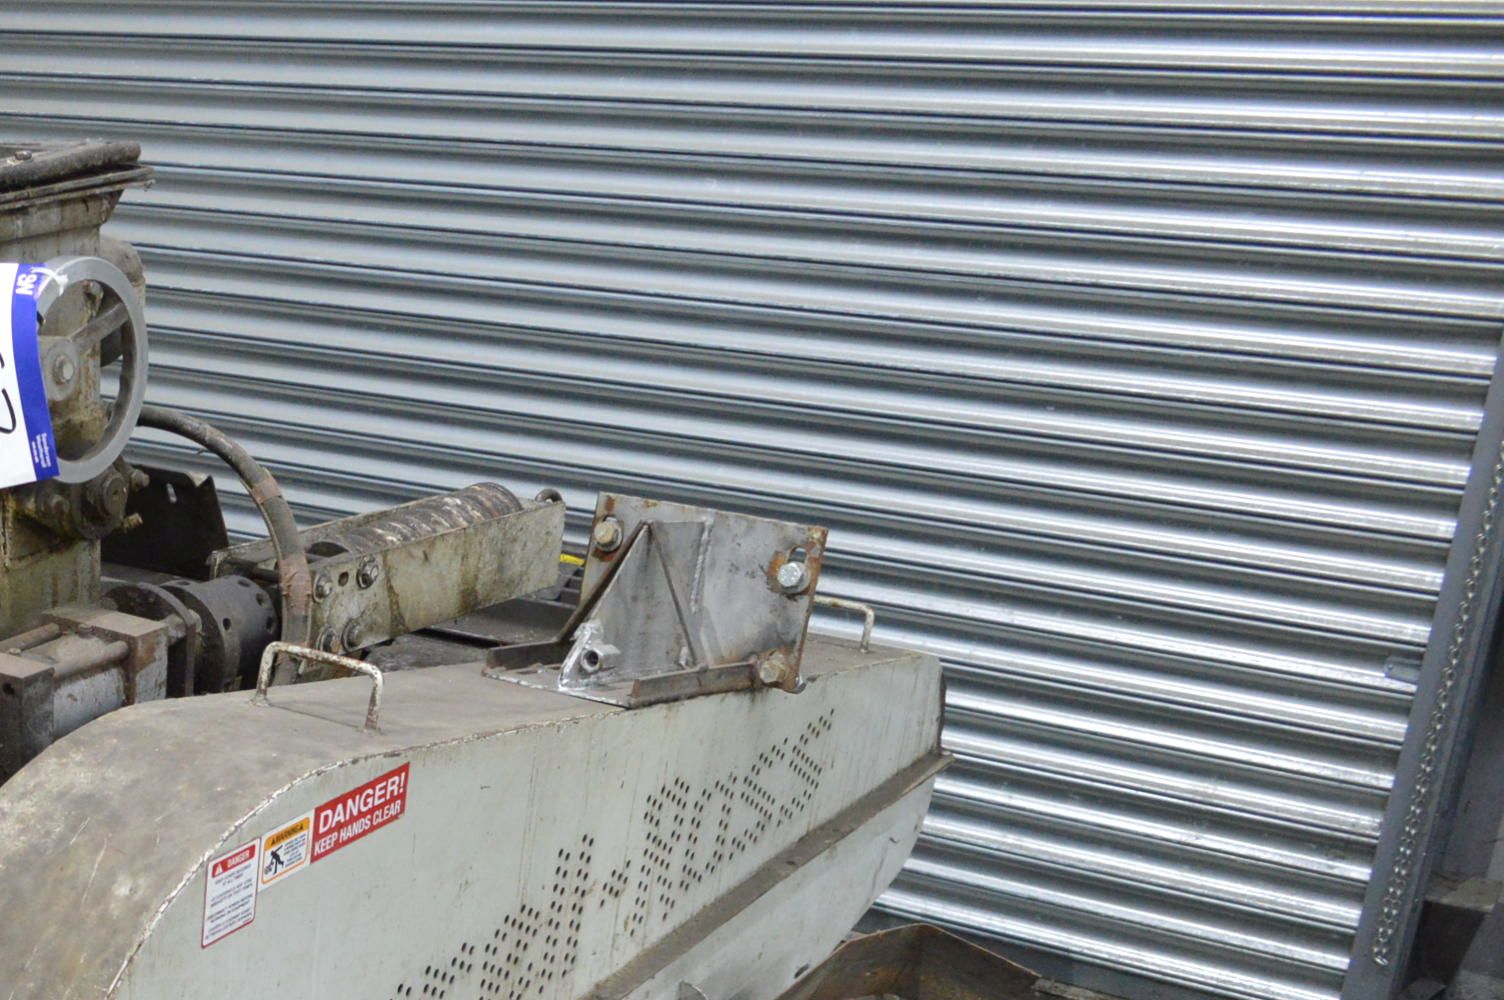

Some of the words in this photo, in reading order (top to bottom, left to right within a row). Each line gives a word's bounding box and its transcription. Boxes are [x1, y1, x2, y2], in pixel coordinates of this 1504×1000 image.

[314, 832, 338, 857] KEEP
[339, 815, 371, 842] HANDS
[372, 799, 401, 826] CLEAR
[318, 771, 406, 835] DANGER!
